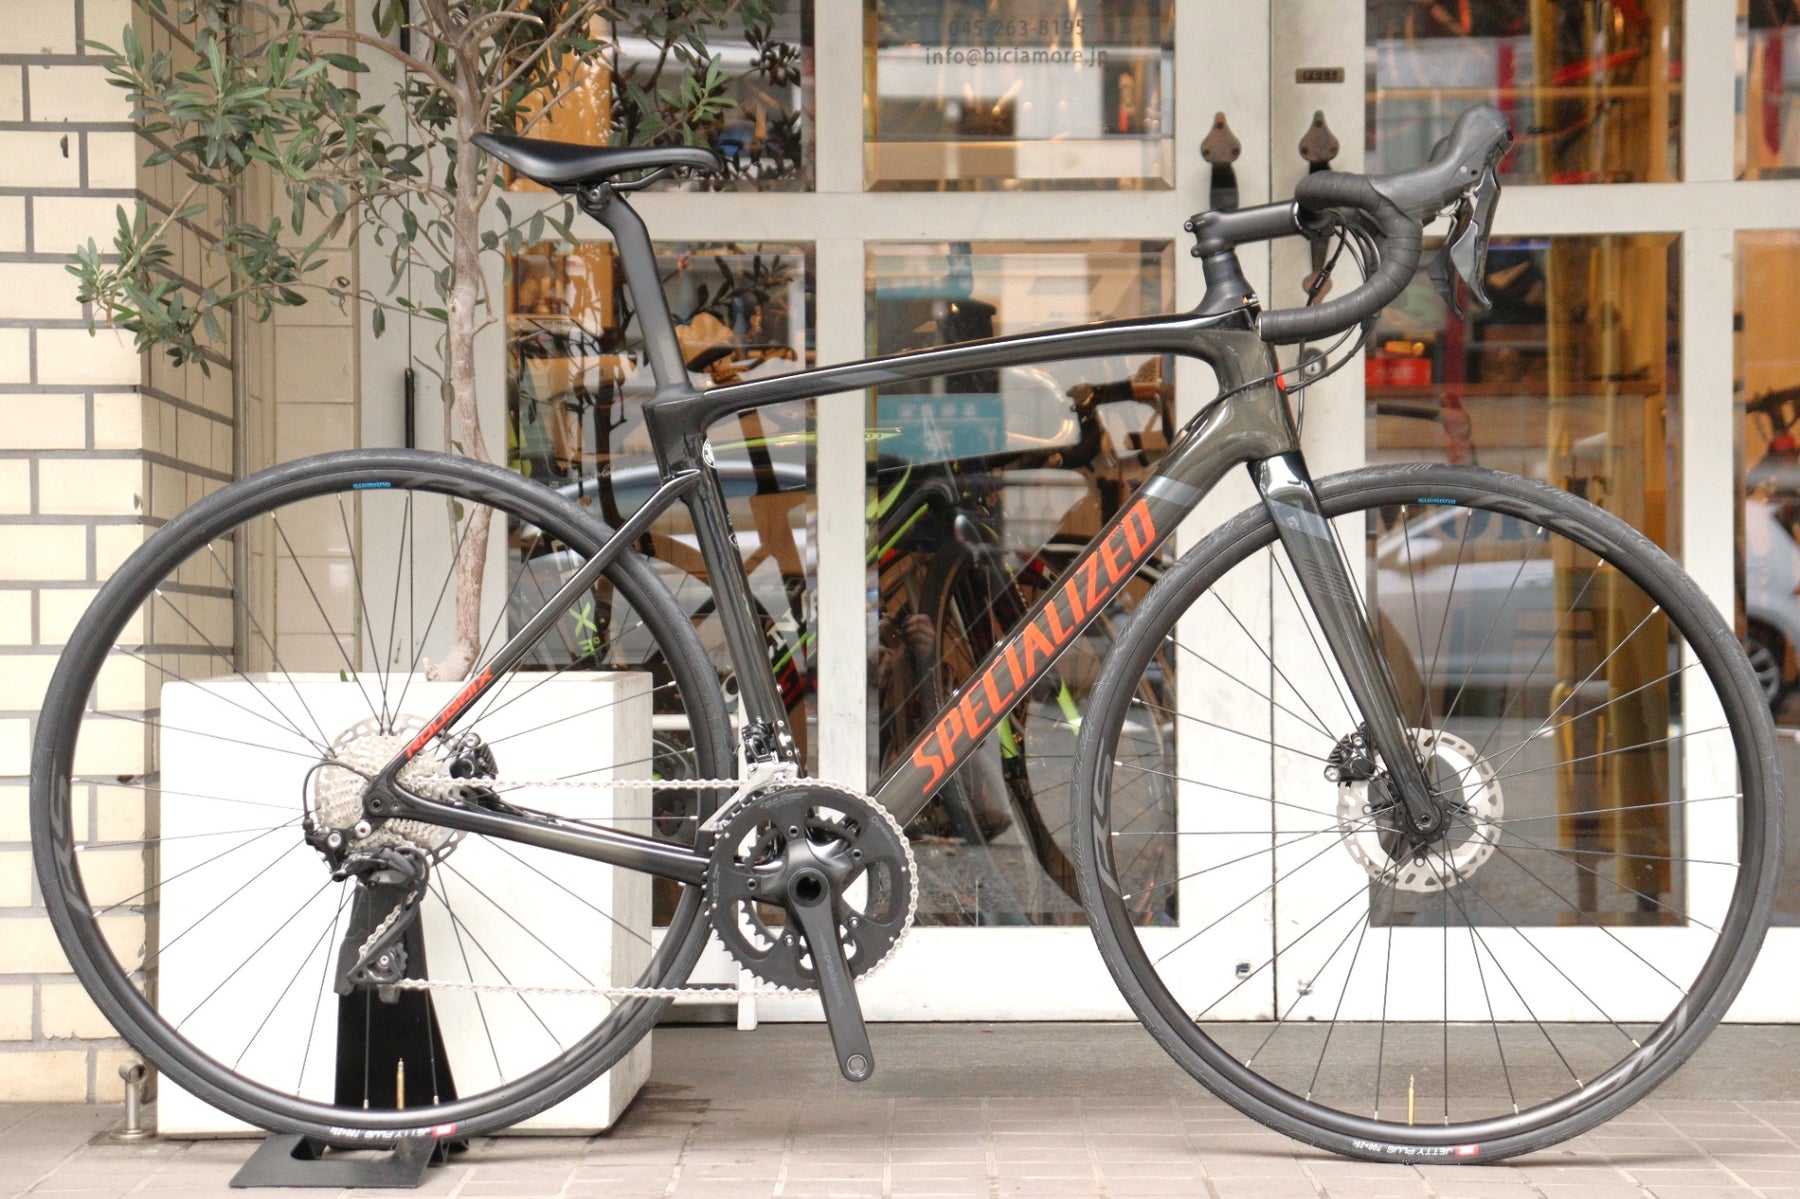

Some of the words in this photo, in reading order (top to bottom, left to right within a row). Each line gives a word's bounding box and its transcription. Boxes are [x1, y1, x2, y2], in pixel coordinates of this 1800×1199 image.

[925, 46, 1108, 67] info@biciamore.jp
[912, 498, 1157, 794] SPECIALIZED
[405, 665, 495, 760] ROUBAIX
[1387, 1146, 1415, 1154] PLUS
[1416, 1146, 1453, 1156] JETTY
